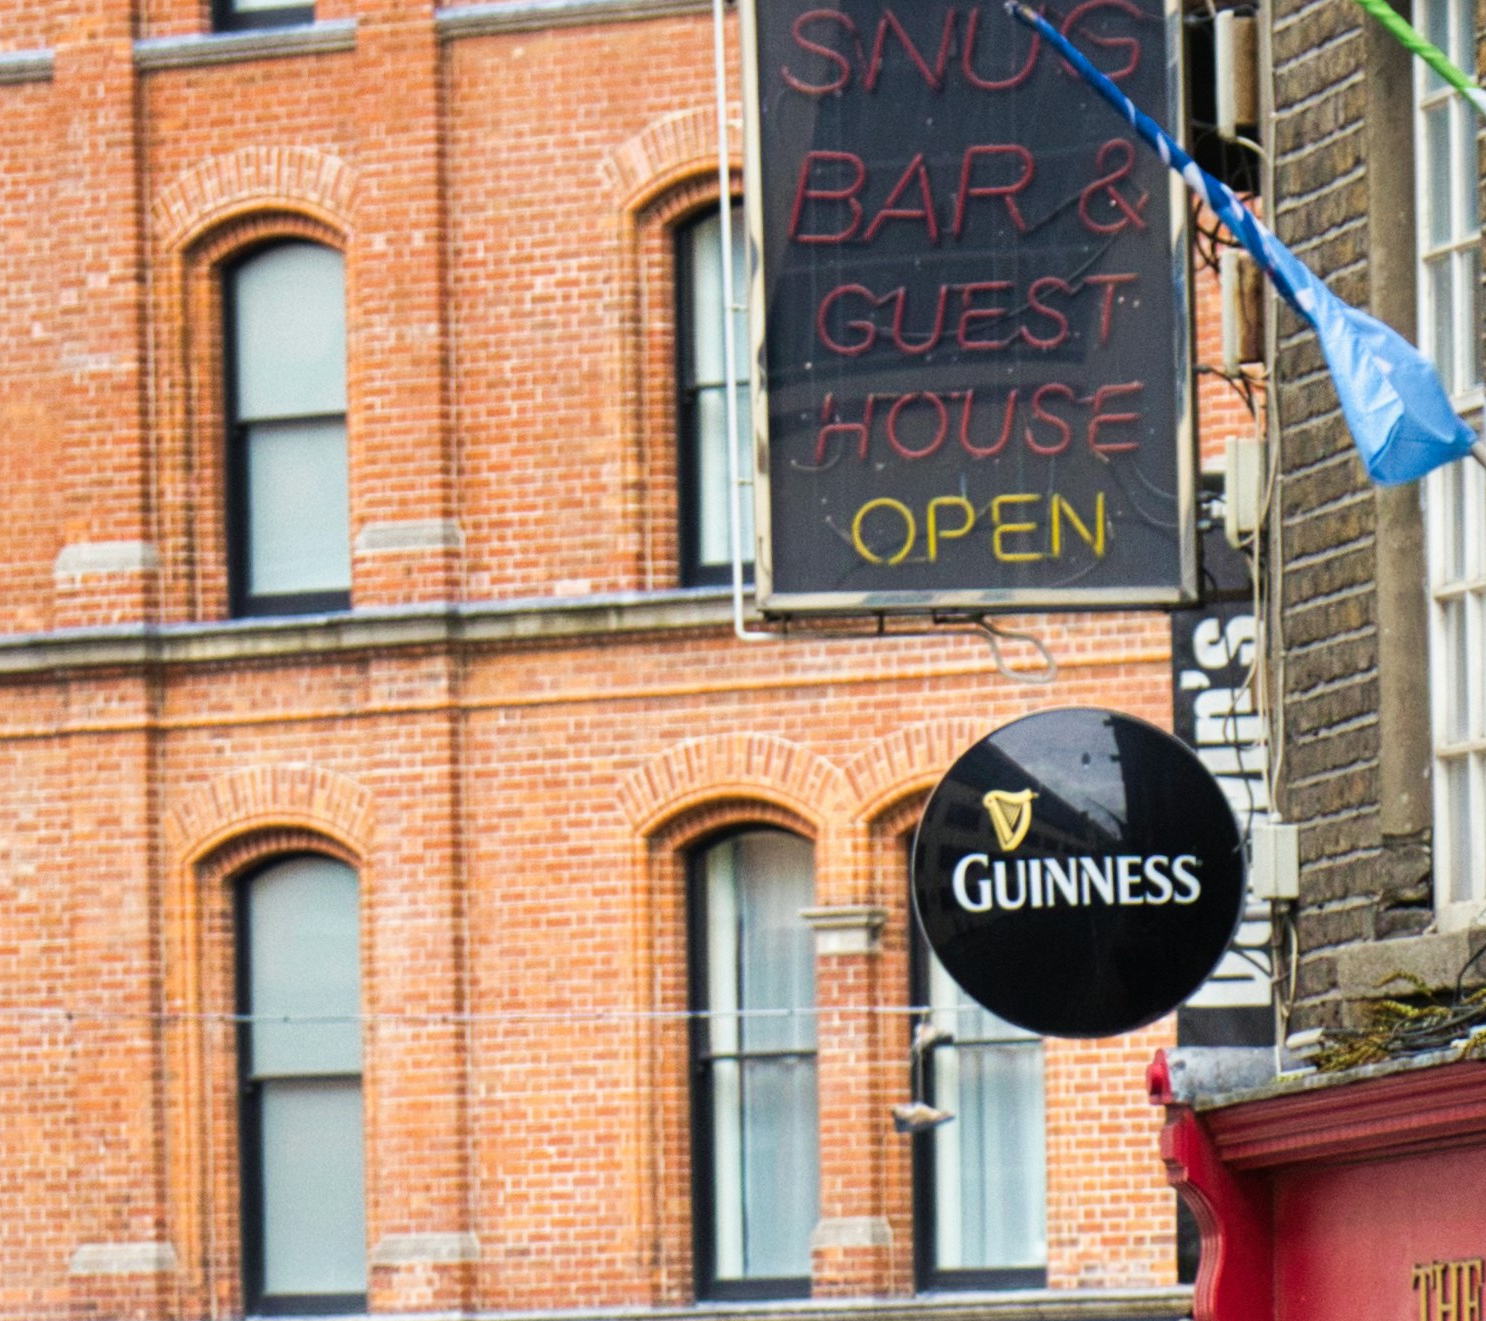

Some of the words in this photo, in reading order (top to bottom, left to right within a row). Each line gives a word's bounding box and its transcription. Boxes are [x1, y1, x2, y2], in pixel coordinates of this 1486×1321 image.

[781, 0, 1142, 95] SNUG
[788, 144, 1036, 244] BAR
[1077, 138, 1151, 235] &
[817, 272, 1141, 356] GUEST
[816, 380, 1145, 461] HOUSE
[852, 491, 1106, 566] OPEN
[951, 852, 1204, 913] GUINNESS
